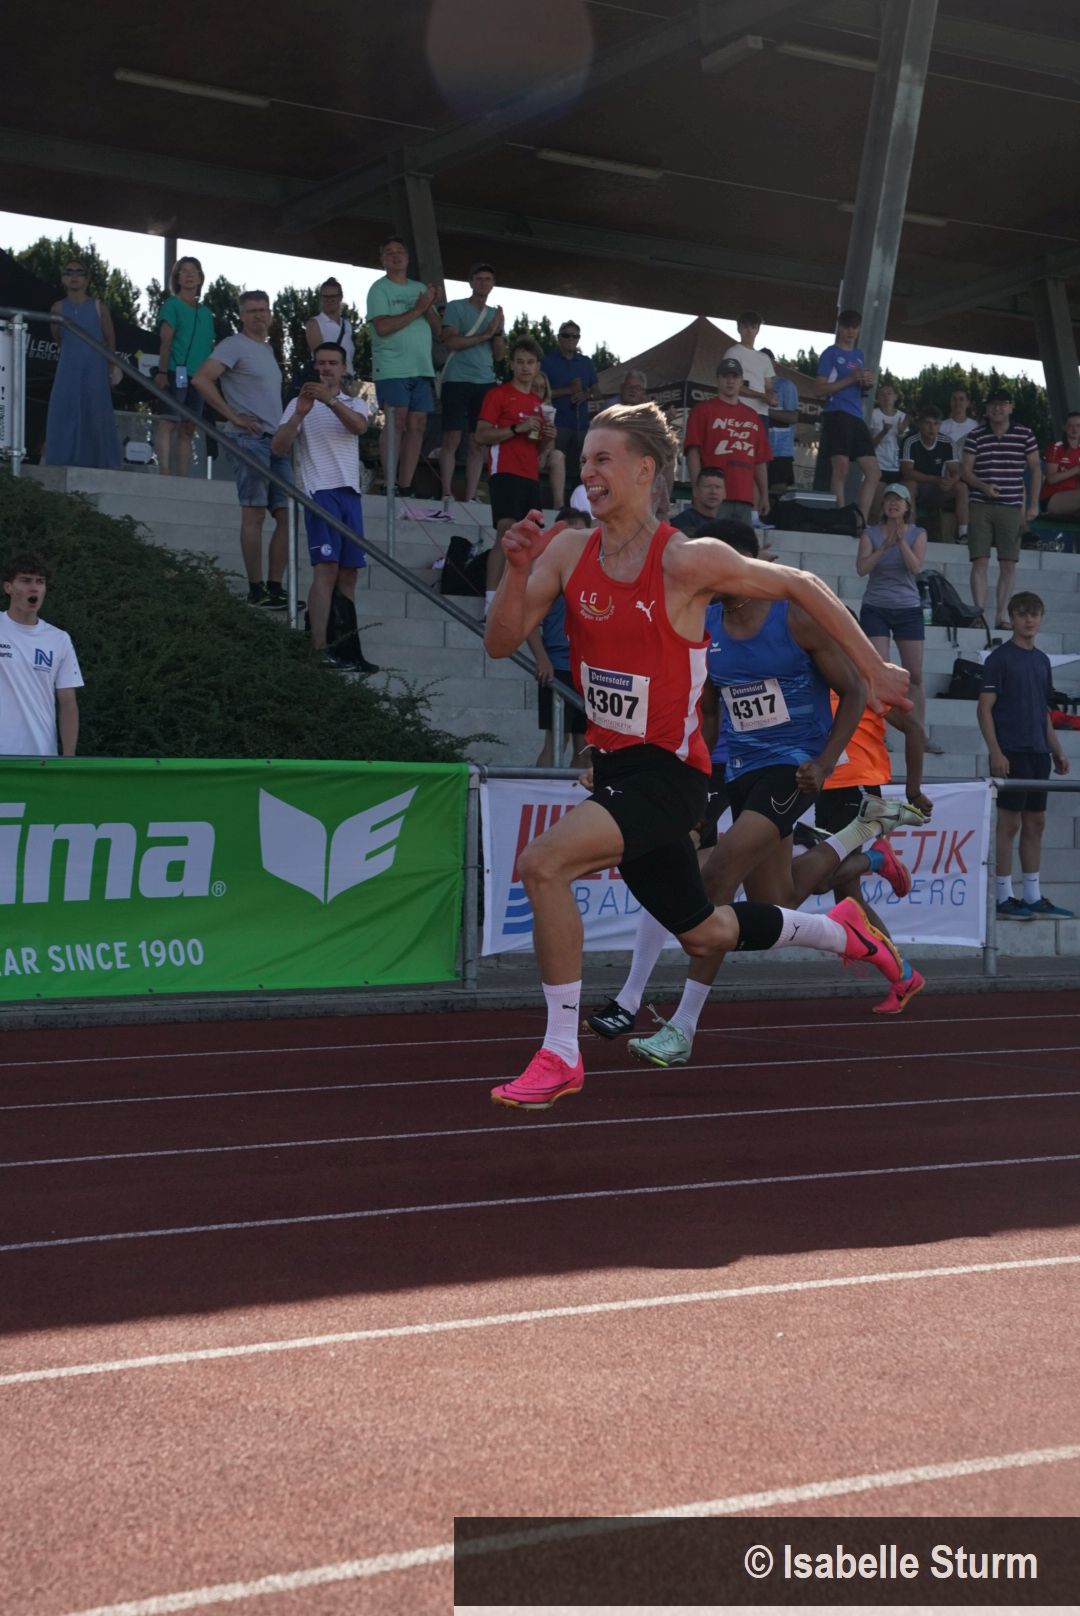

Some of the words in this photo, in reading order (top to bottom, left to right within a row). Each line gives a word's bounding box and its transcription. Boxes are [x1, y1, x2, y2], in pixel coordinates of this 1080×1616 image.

[590, 671, 630, 687] Peterstaler
[732, 683, 764, 696] Peterstaler
[588, 686, 640, 720] 4307
[732, 693, 776, 720] 4317
[0, 947, 40, 976] AR
[49, 941, 131, 972] SINCE
[138, 938, 205, 969] 1900
